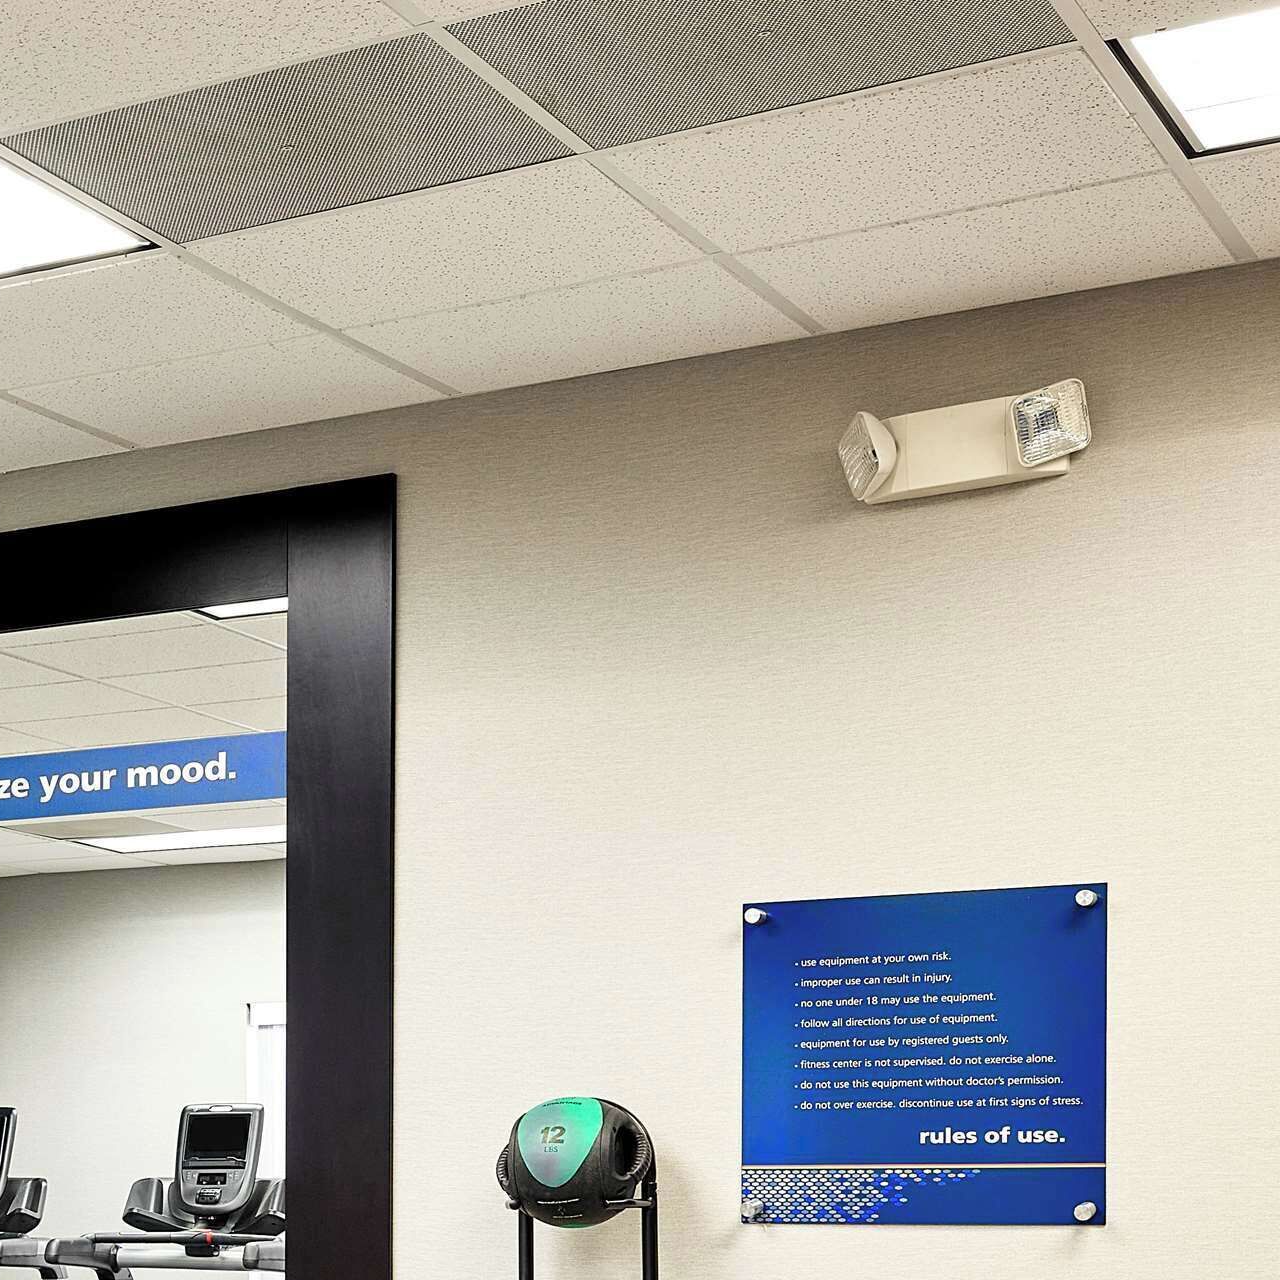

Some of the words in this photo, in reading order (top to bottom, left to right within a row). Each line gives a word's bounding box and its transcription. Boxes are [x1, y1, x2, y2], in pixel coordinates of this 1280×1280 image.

[39, 767, 117, 803] your
[127, 751, 236, 788] mood.
[800, 959, 817, 967] use
[818, 955, 870, 968] equipment
[871, 955, 882, 964] at
[883, 955, 906, 966] your
[907, 954, 929, 963] own
[931, 951, 952, 961] risk.
[800, 978, 843, 989] improper
[845, 977, 862, 986] use
[863, 977, 881, 985] can
[883, 973, 910, 984] result
[911, 973, 921, 983] in
[923, 972, 953, 984] injury.
[800, 1000, 814, 1008] no
[815, 999, 834, 1008] one
[835, 996, 864, 1007] under
[866, 995, 879, 1005] 18
[880, 997, 901, 1007] may
[903, 995, 921, 1004] use
[921, 993, 939, 1004] the
[940, 992, 997, 1005] equipment.
[799, 1018, 831, 1029] follow
[831, 1017, 843, 1028] all
[845, 1016, 891, 1027] directions
[893, 1015, 908, 1025] for
[909, 1016, 927, 1025] use
[928, 1013, 941, 1024] of
[941, 1013, 998, 1025] equipment.
[799, 1039, 851, 1051] equipment
[851, 1037, 867, 1047] for
[869, 1039, 886, 1047] use
[887, 1036, 901, 1048] by
[901, 1035, 950, 1048] registered
[951, 1035, 984, 1047] guests
[985, 1033, 1009, 1045] only.
[799, 1059, 831, 1069] fitness
[832, 1059, 863, 1069] center
[864, 1058, 873, 1068] is
[874, 1058, 891, 1067] not
[892, 1055, 947, 1069] supervised.
[948, 1055, 963, 1065] do
[964, 1055, 983, 1065] not
[983, 1054, 1024, 1065] exercise
[1025, 1053, 1057, 1064] alone.
[799, 1079, 813, 1090] do
[815, 1080, 832, 1089] not
[833, 1081, 850, 1089] use
[851, 1079, 870, 1089] this
[871, 1078, 923, 1090] equipment
[924, 1076, 964, 1087] without
[1007, 1074, 1064, 1087] permission.
[800, 1100, 813, 1110] do
[815, 1101, 831, 1110] not
[833, 1101, 855, 1110] over
[855, 1099, 896, 1109] exercise.
[898, 1098, 955, 1109] discontinue
[956, 1099, 974, 1107] use
[975, 1098, 987, 1107] at
[988, 1096, 1009, 1107] first
[1010, 1096, 1037, 1109] signs
[1038, 1095, 1050, 1106] of
[1051, 1097, 1084, 1106] stress.
[541, 1125, 566, 1144] 12
[919, 1126, 978, 1145] rules
[984, 1125, 1011, 1144] of
[1017, 1129, 1066, 1144] use.
